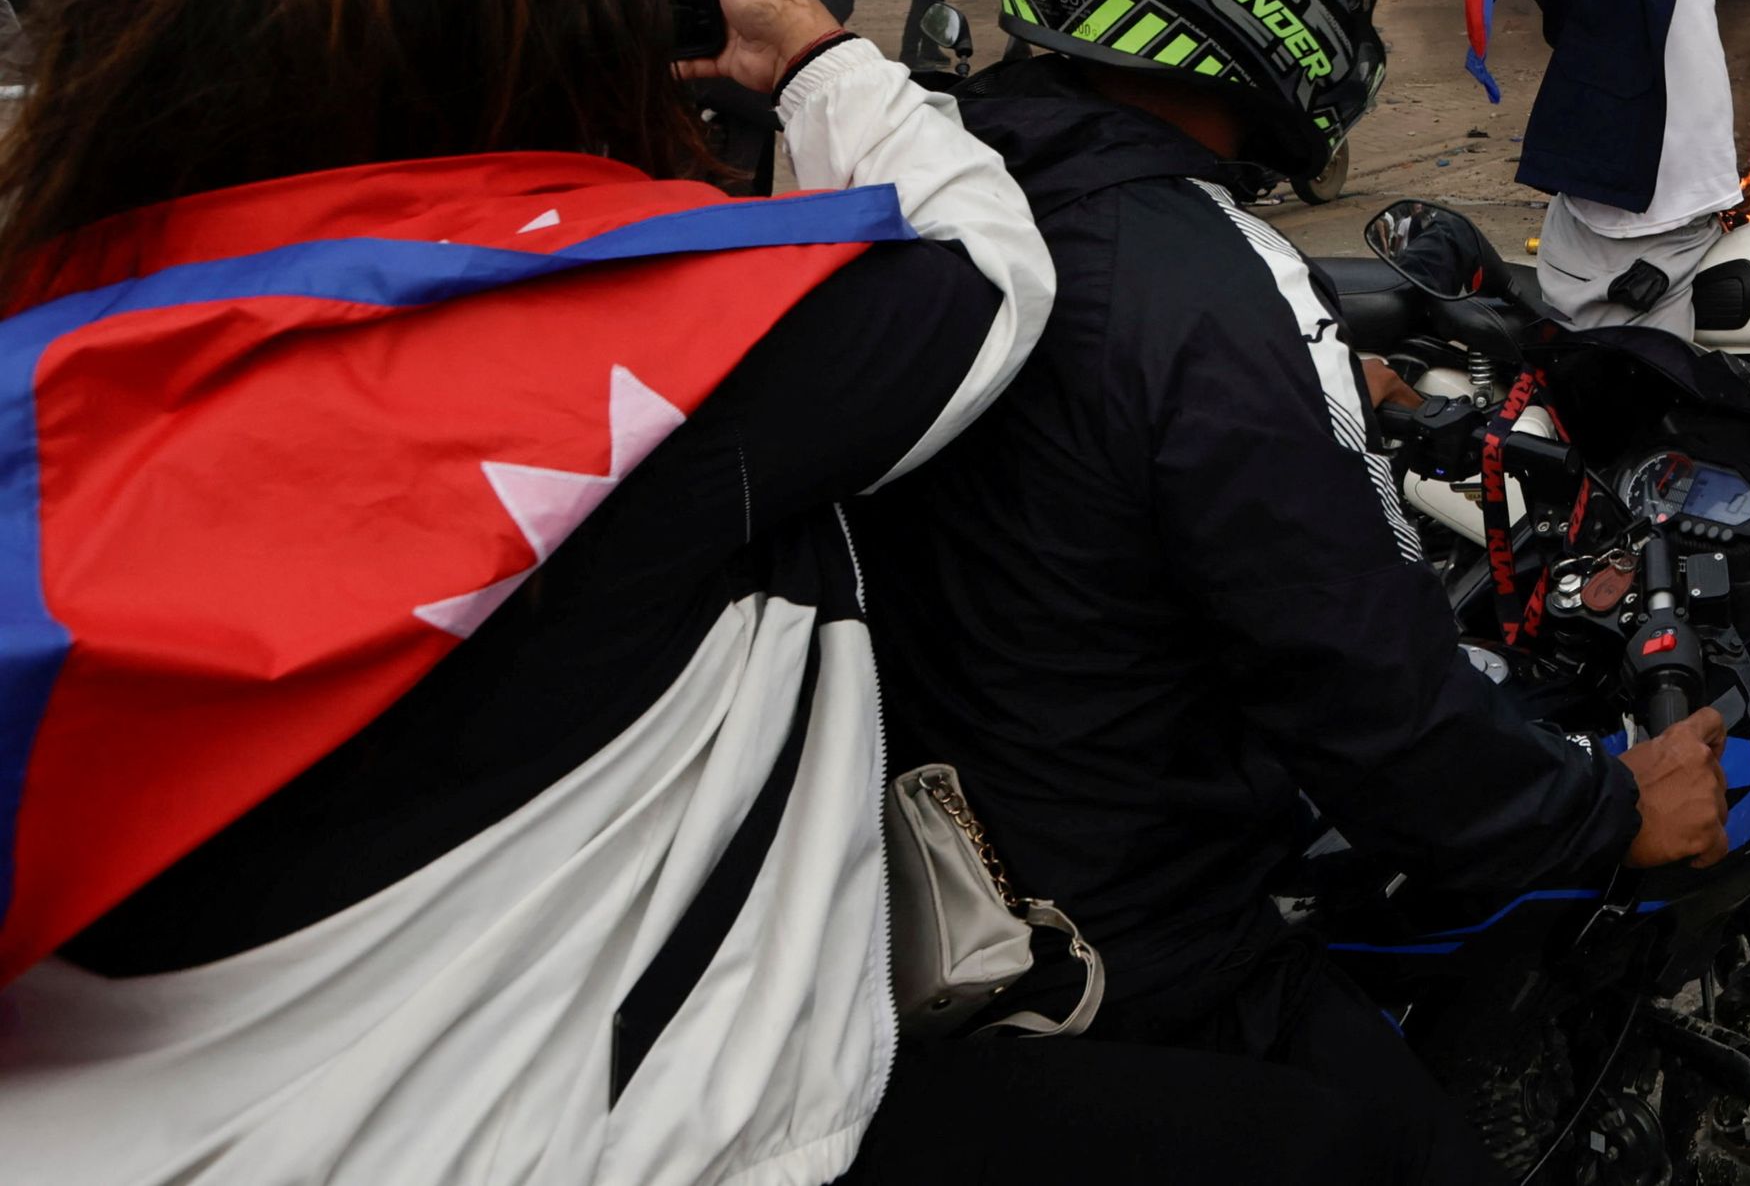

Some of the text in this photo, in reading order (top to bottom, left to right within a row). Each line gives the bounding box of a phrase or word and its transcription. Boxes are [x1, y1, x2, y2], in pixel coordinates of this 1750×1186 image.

[1500, 372, 1534, 420] KTM
[1482, 433, 1505, 502] KTM
[1487, 528, 1515, 595] KTM
